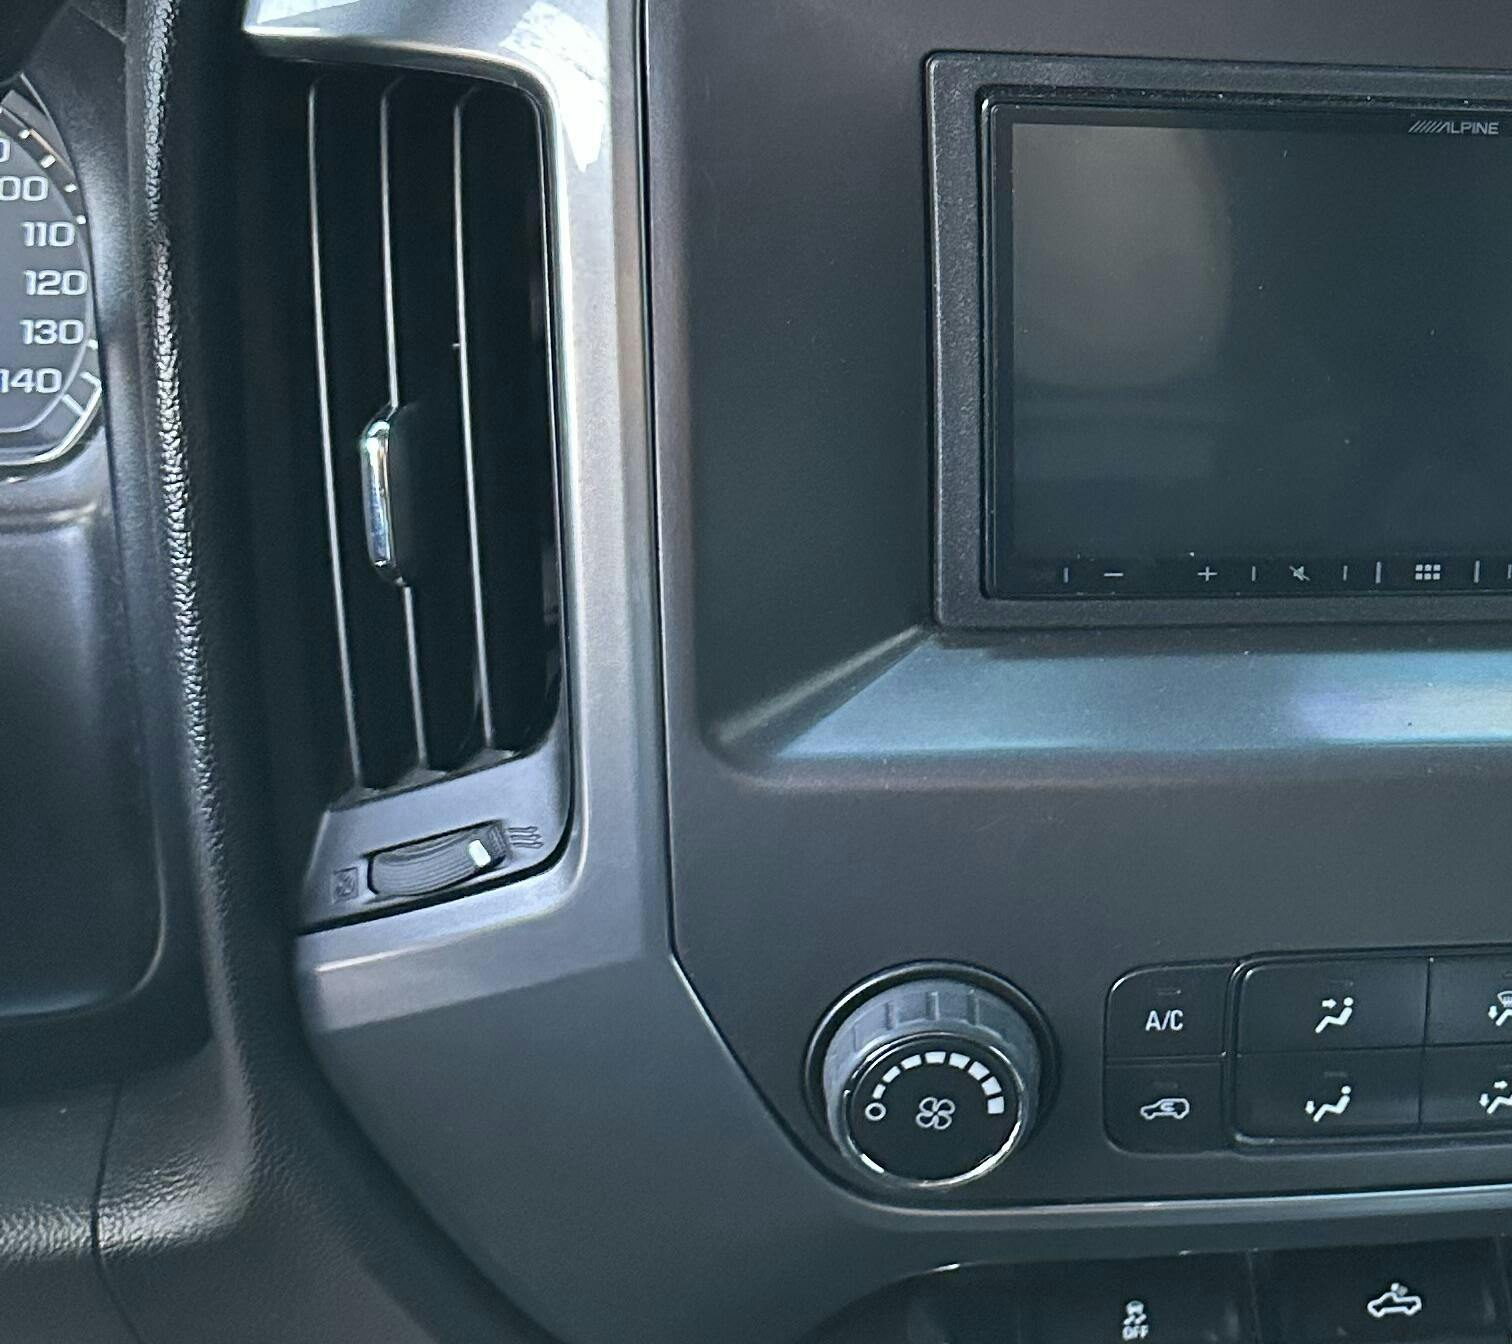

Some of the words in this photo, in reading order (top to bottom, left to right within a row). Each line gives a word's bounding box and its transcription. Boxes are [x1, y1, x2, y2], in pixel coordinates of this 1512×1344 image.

[0, 176, 49, 201] 00
[20, 221, 76, 248] 110
[23, 269, 89, 296] 120
[19, 319, 85, 345] 130
[0, 368, 63, 395] 140
[1145, 1009, 1184, 1031] A/C
